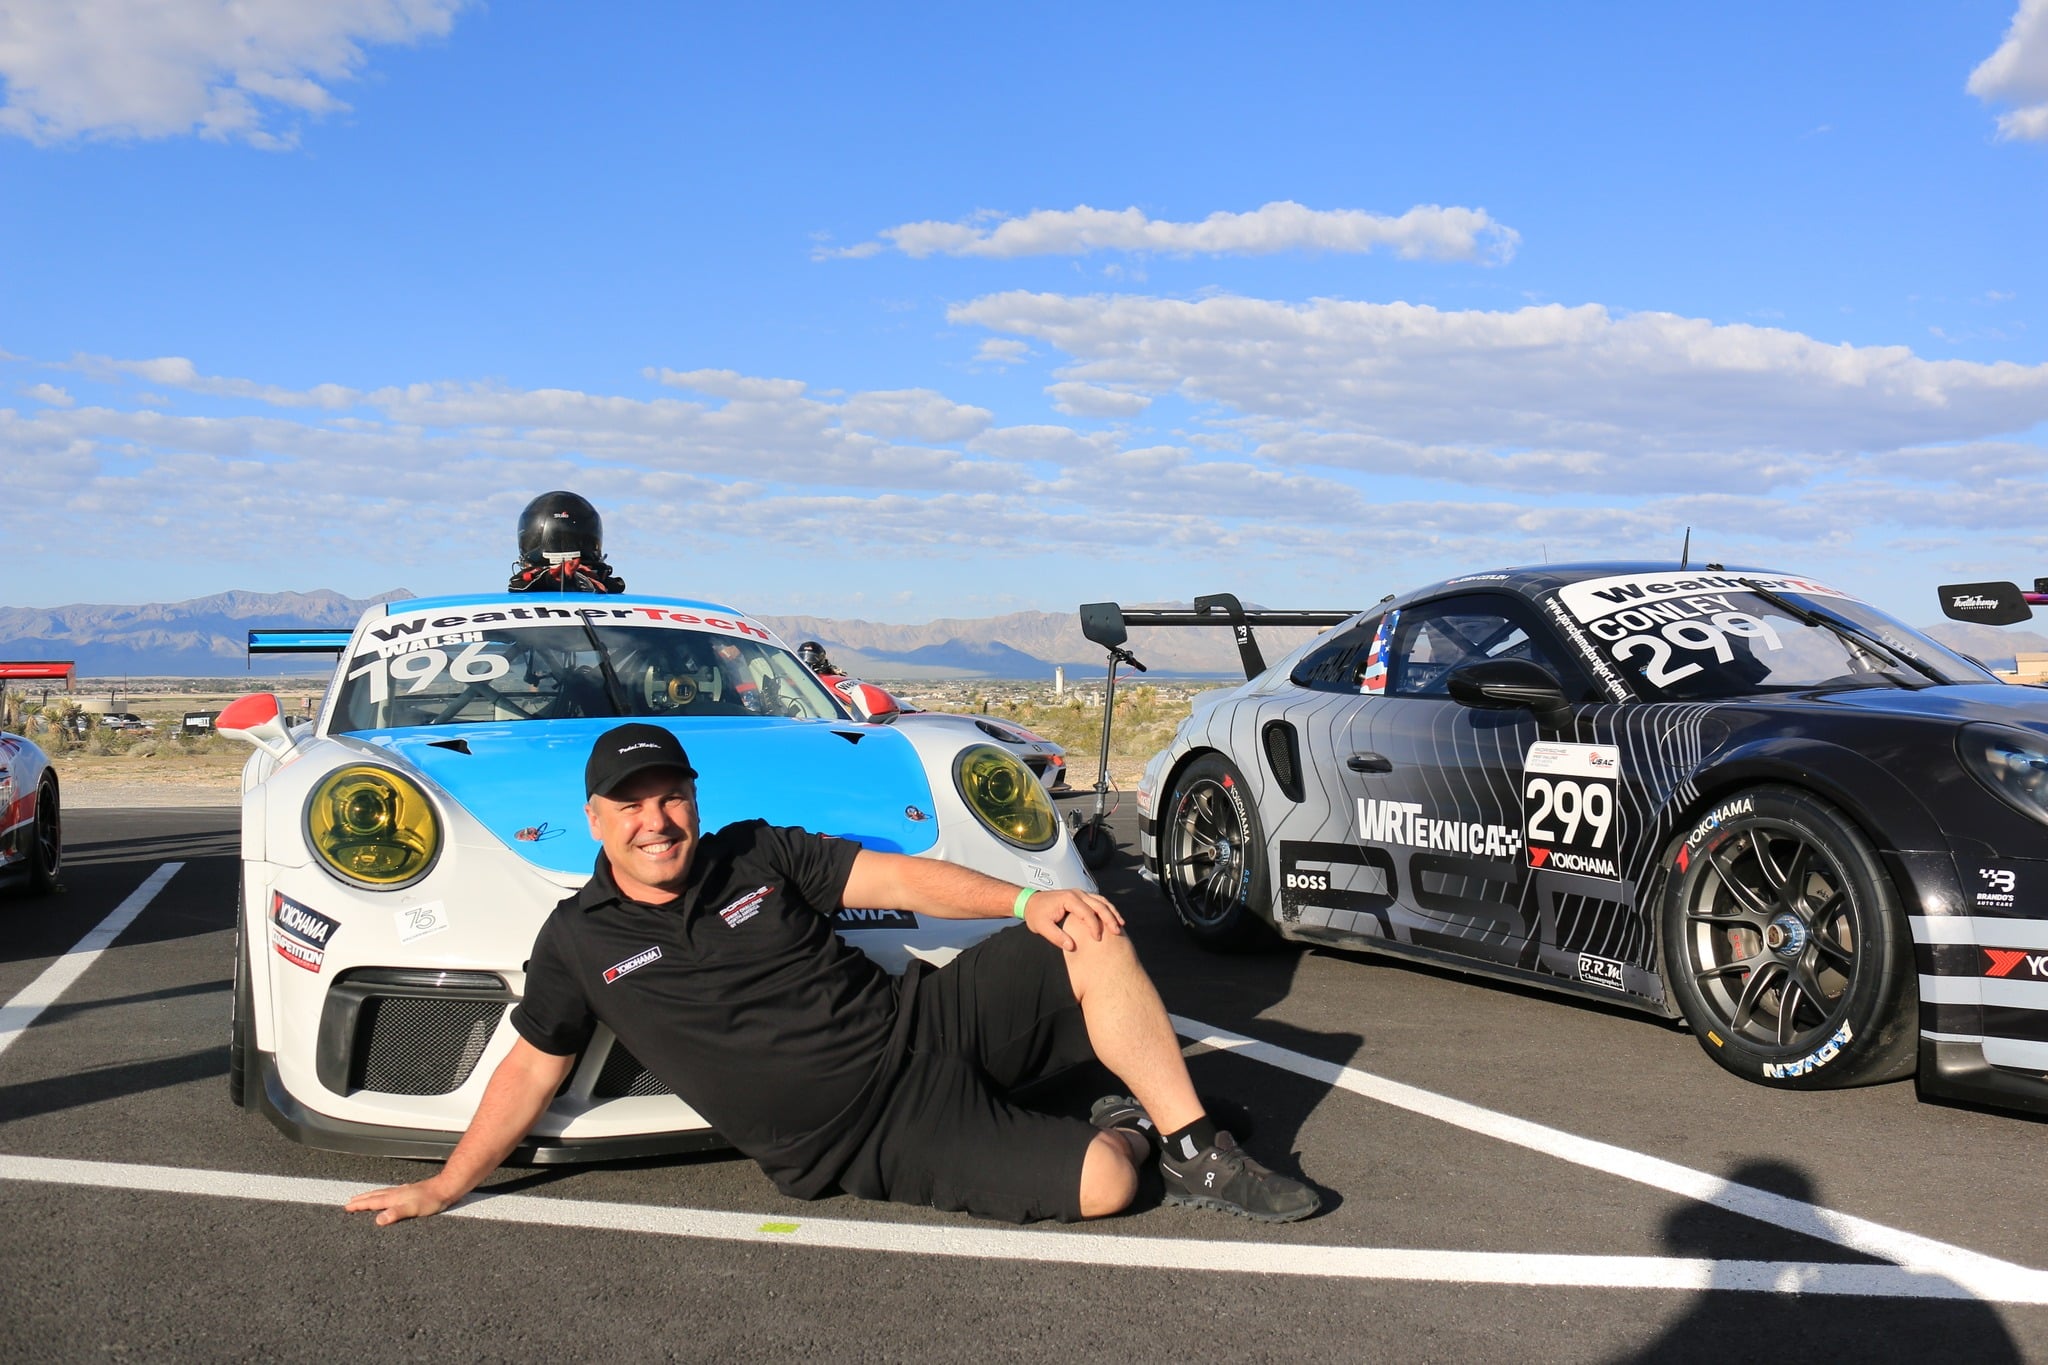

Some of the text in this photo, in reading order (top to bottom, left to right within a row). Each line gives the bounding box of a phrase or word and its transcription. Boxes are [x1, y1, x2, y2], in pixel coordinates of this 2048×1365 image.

[371, 606, 769, 642] WeatherTech
[1589, 594, 1738, 641] CONLEY
[377, 631, 485, 660] WALSH
[1545, 597, 1628, 702] www.porschemotorsport.com
[1611, 611, 1784, 689] 299
[348, 641, 510, 704] 196
[1231, 784, 1250, 844] YOKOHAMA
[1526, 778, 1613, 849] 299
[1686, 798, 1753, 849] YOKOHAMA
[1286, 873, 1327, 891] BOSS
[1549, 851, 1617, 877] YOKOHAMA
[719, 885, 769, 917] PORSCHE
[1976, 893, 2015, 902] BRANDO'S
[278, 901, 330, 943] YOKOHAMA
[404, 907, 437, 930] 75
[615, 950, 659, 975] YOKOHAMA
